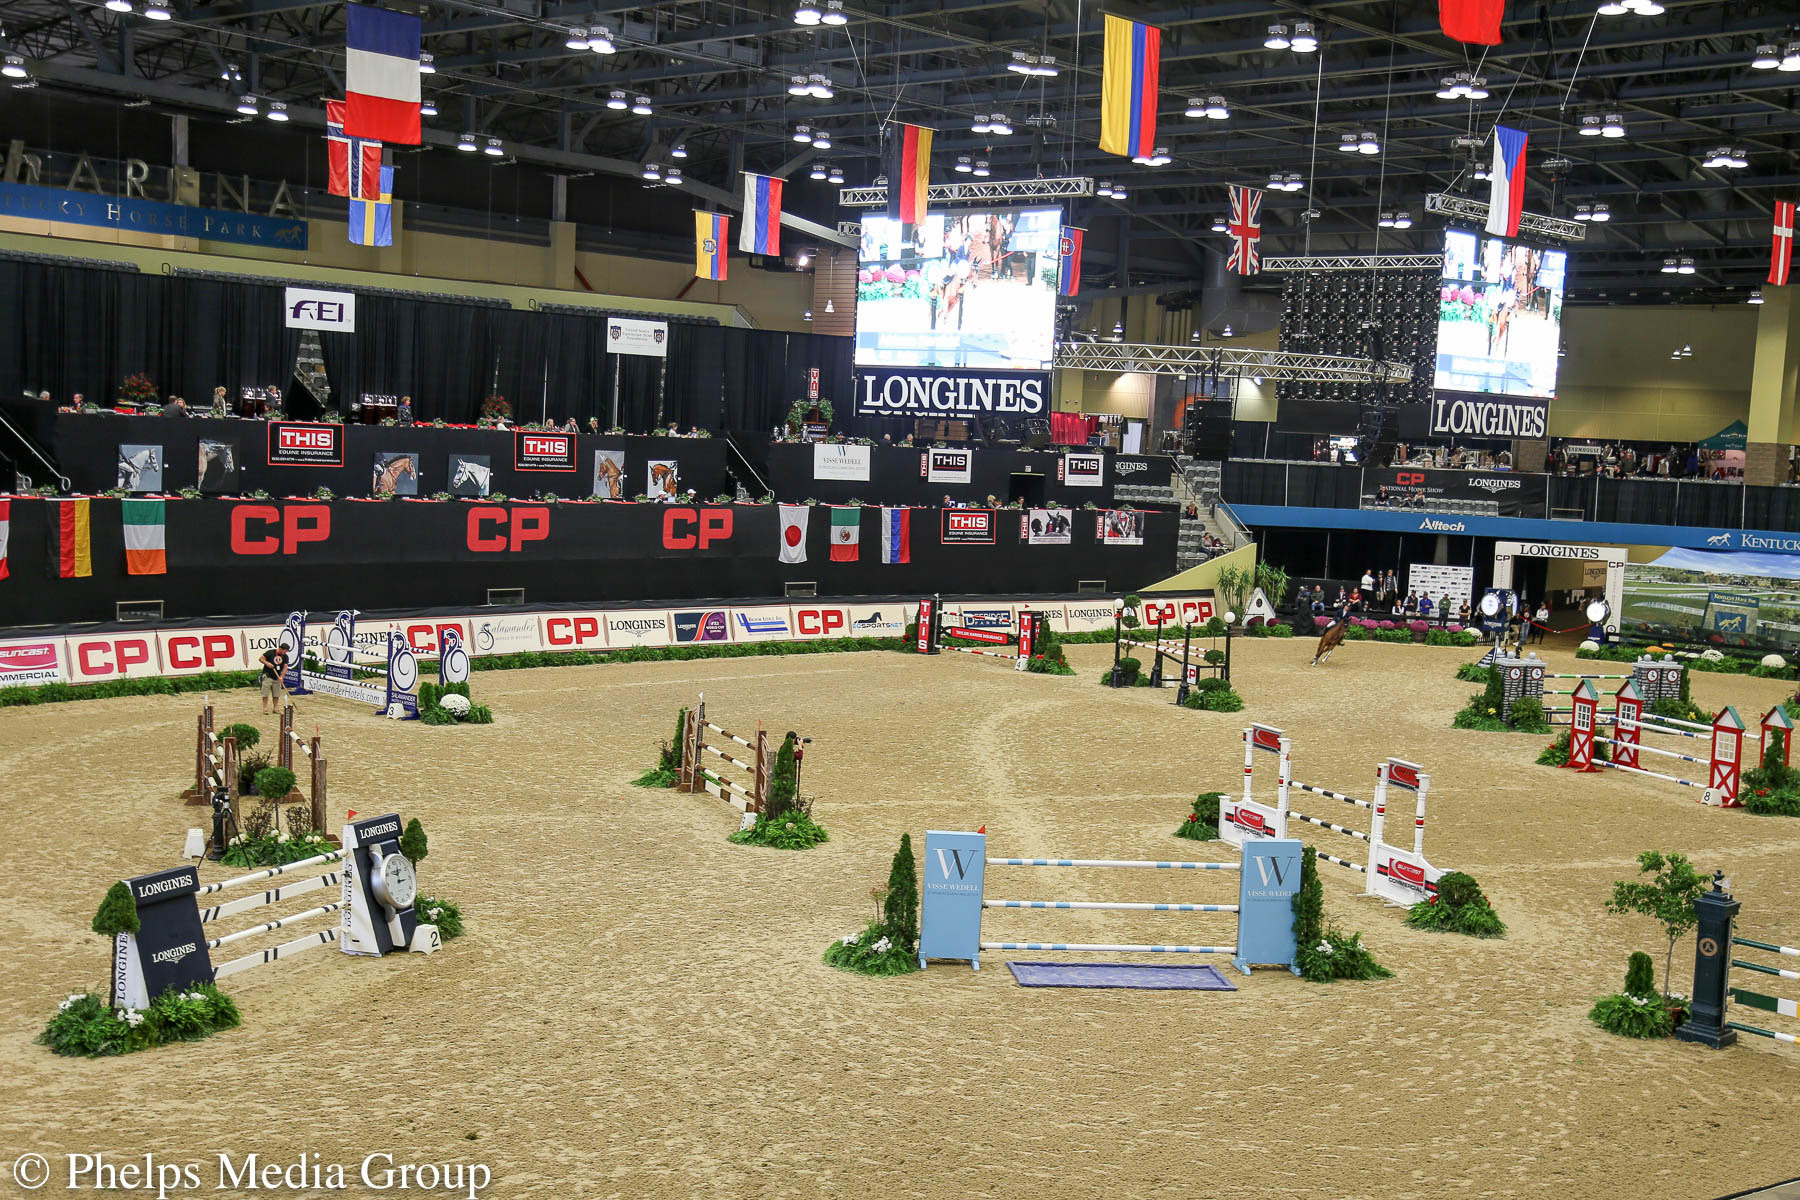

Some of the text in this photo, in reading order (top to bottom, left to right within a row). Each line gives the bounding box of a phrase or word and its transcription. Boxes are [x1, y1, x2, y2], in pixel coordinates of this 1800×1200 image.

[204, 215, 262, 238] PARK
[863, 375, 1043, 414] LONGINES
[1434, 399, 1546, 438] LONGINES
[282, 431, 331, 447] THIS
[526, 440, 566, 453] THIS
[934, 455, 966, 466] THIS
[1070, 460, 1098, 470] THIS
[1396, 472, 1425, 486] CP
[1468, 478, 1521, 488] LONGINES
[231, 504, 331, 556] CP
[467, 507, 550, 552] CP
[662, 508, 733, 550] CP
[951, 516, 987, 528] THIS
[1418, 517, 1465, 532] Alltech
[1520, 544, 1600, 559] LONGINES
[1584, 567, 1607, 575] LONGINES
[1608, 561, 1624, 569] CP
[1069, 608, 1113, 618] LONGINES
[1145, 603, 1176, 625] CP
[546, 617, 599, 645] CP
[610, 620, 666, 631] LONGINES
[798, 610, 844, 635] CP
[918, 602, 930, 650] THIS
[407, 624, 464, 654] CP
[1020, 614, 1032, 659] THI
[78, 639, 149, 676] CP
[168, 635, 235, 670] CP
[388, 706, 395, 716] 3
[1704, 791, 1711, 802] 8
[360, 822, 398, 840] LONGINES
[138, 875, 193, 898] LONGINES
[949, 884, 979, 892] WEDELL
[430, 931, 439, 948] 2
[152, 942, 197, 963] LONGINES
